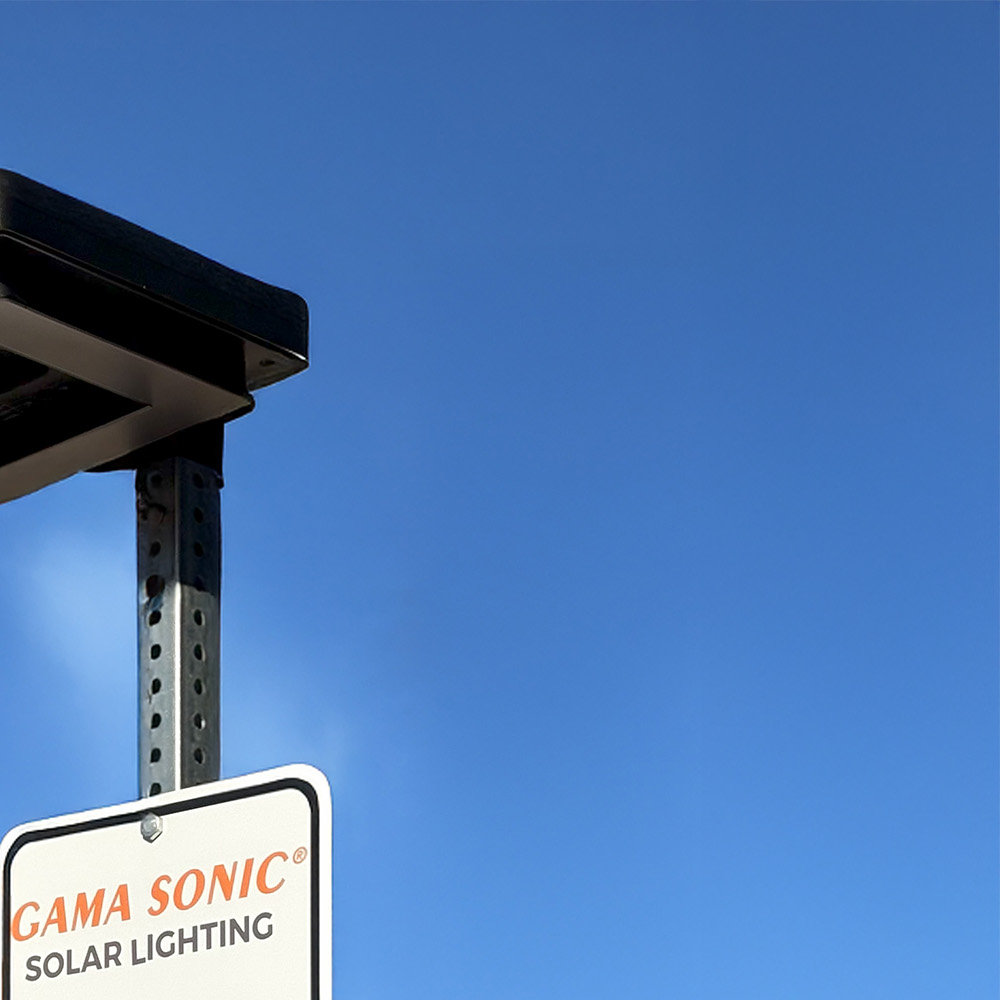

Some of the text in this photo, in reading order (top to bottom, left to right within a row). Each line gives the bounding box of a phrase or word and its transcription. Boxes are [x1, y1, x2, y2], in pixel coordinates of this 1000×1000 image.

[11, 883, 131, 942] GAMA
[25, 911, 274, 982] SOLAR LIGHTING
